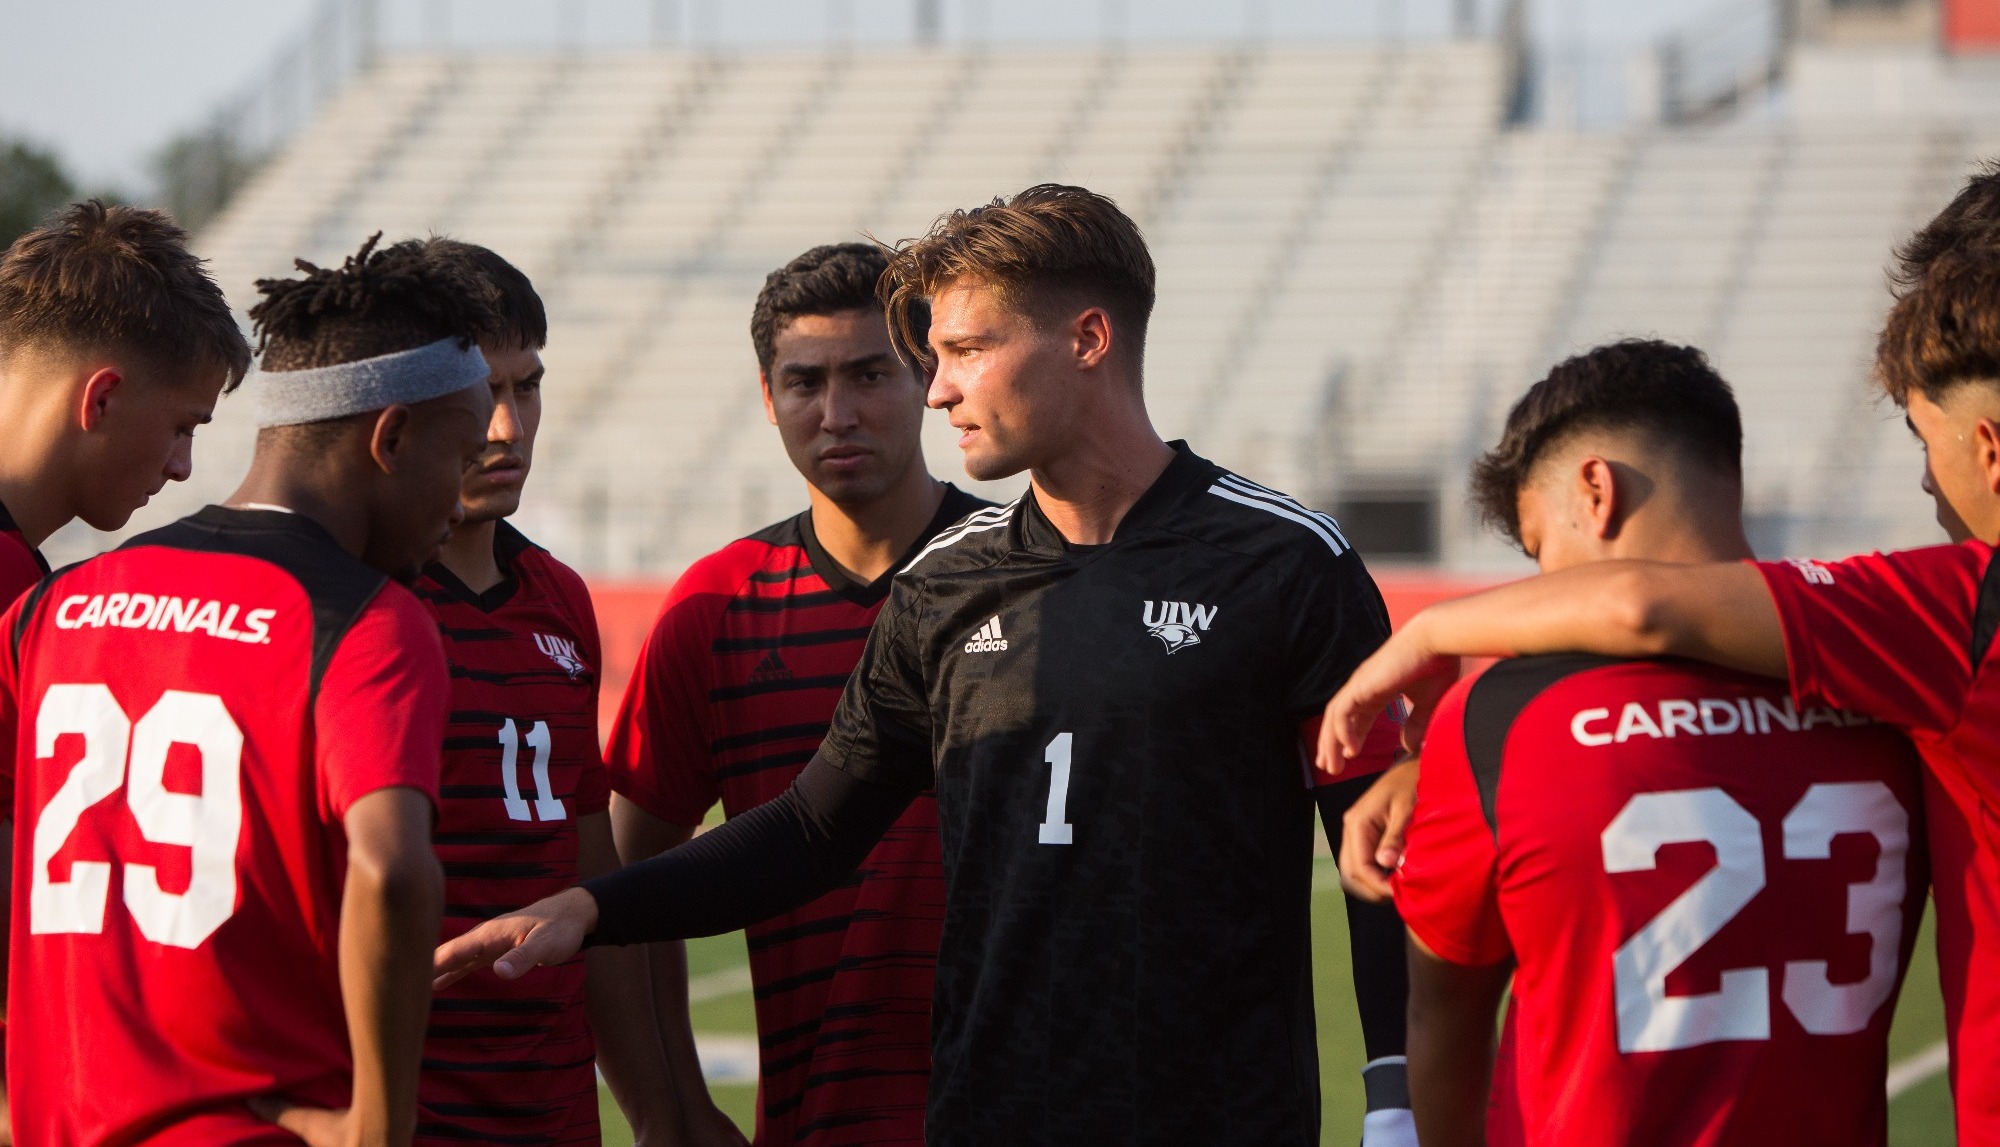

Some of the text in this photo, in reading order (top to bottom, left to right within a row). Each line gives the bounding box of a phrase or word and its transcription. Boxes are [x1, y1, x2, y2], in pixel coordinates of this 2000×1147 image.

[965, 638, 1008, 653] adidas
[1143, 601, 1218, 630] UIW
[498, 718, 567, 821] 11
[1570, 697, 1882, 746] CARDINAL
[31, 684, 243, 949] 29
[1039, 733, 1073, 844] 1
[1601, 781, 1909, 1053] 23
